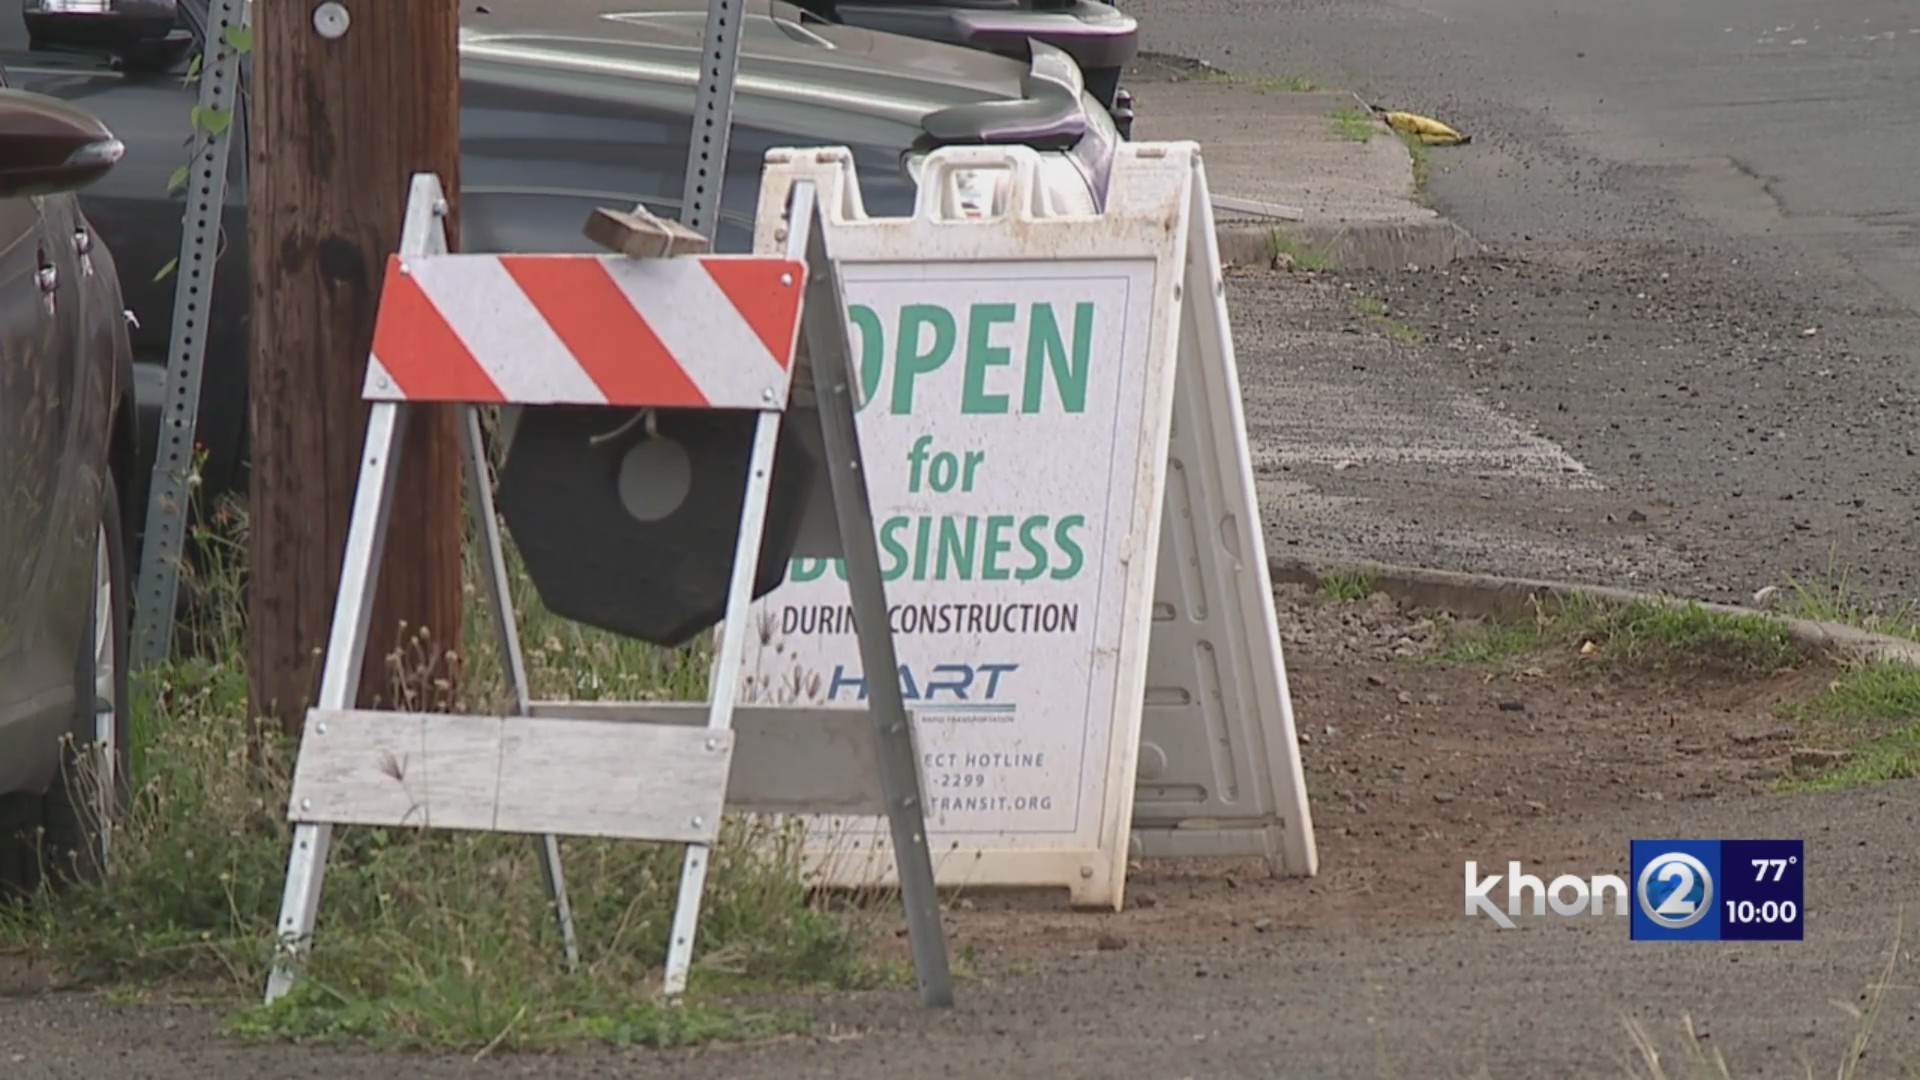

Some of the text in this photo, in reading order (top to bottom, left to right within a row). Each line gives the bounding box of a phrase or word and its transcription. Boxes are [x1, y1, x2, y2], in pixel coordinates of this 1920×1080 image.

[848, 303, 1094, 415] OPEN
[907, 435, 984, 494] for
[790, 514, 1085, 583] SINESS
[782, 603, 1079, 635] DURIN CONSTRUCTION
[828, 664, 1019, 700] HART
[924, 752, 1045, 767] ECT HOTLINE
[934, 773, 985, 787] -2299
[930, 796, 1051, 811] TRANSIT.ORG
